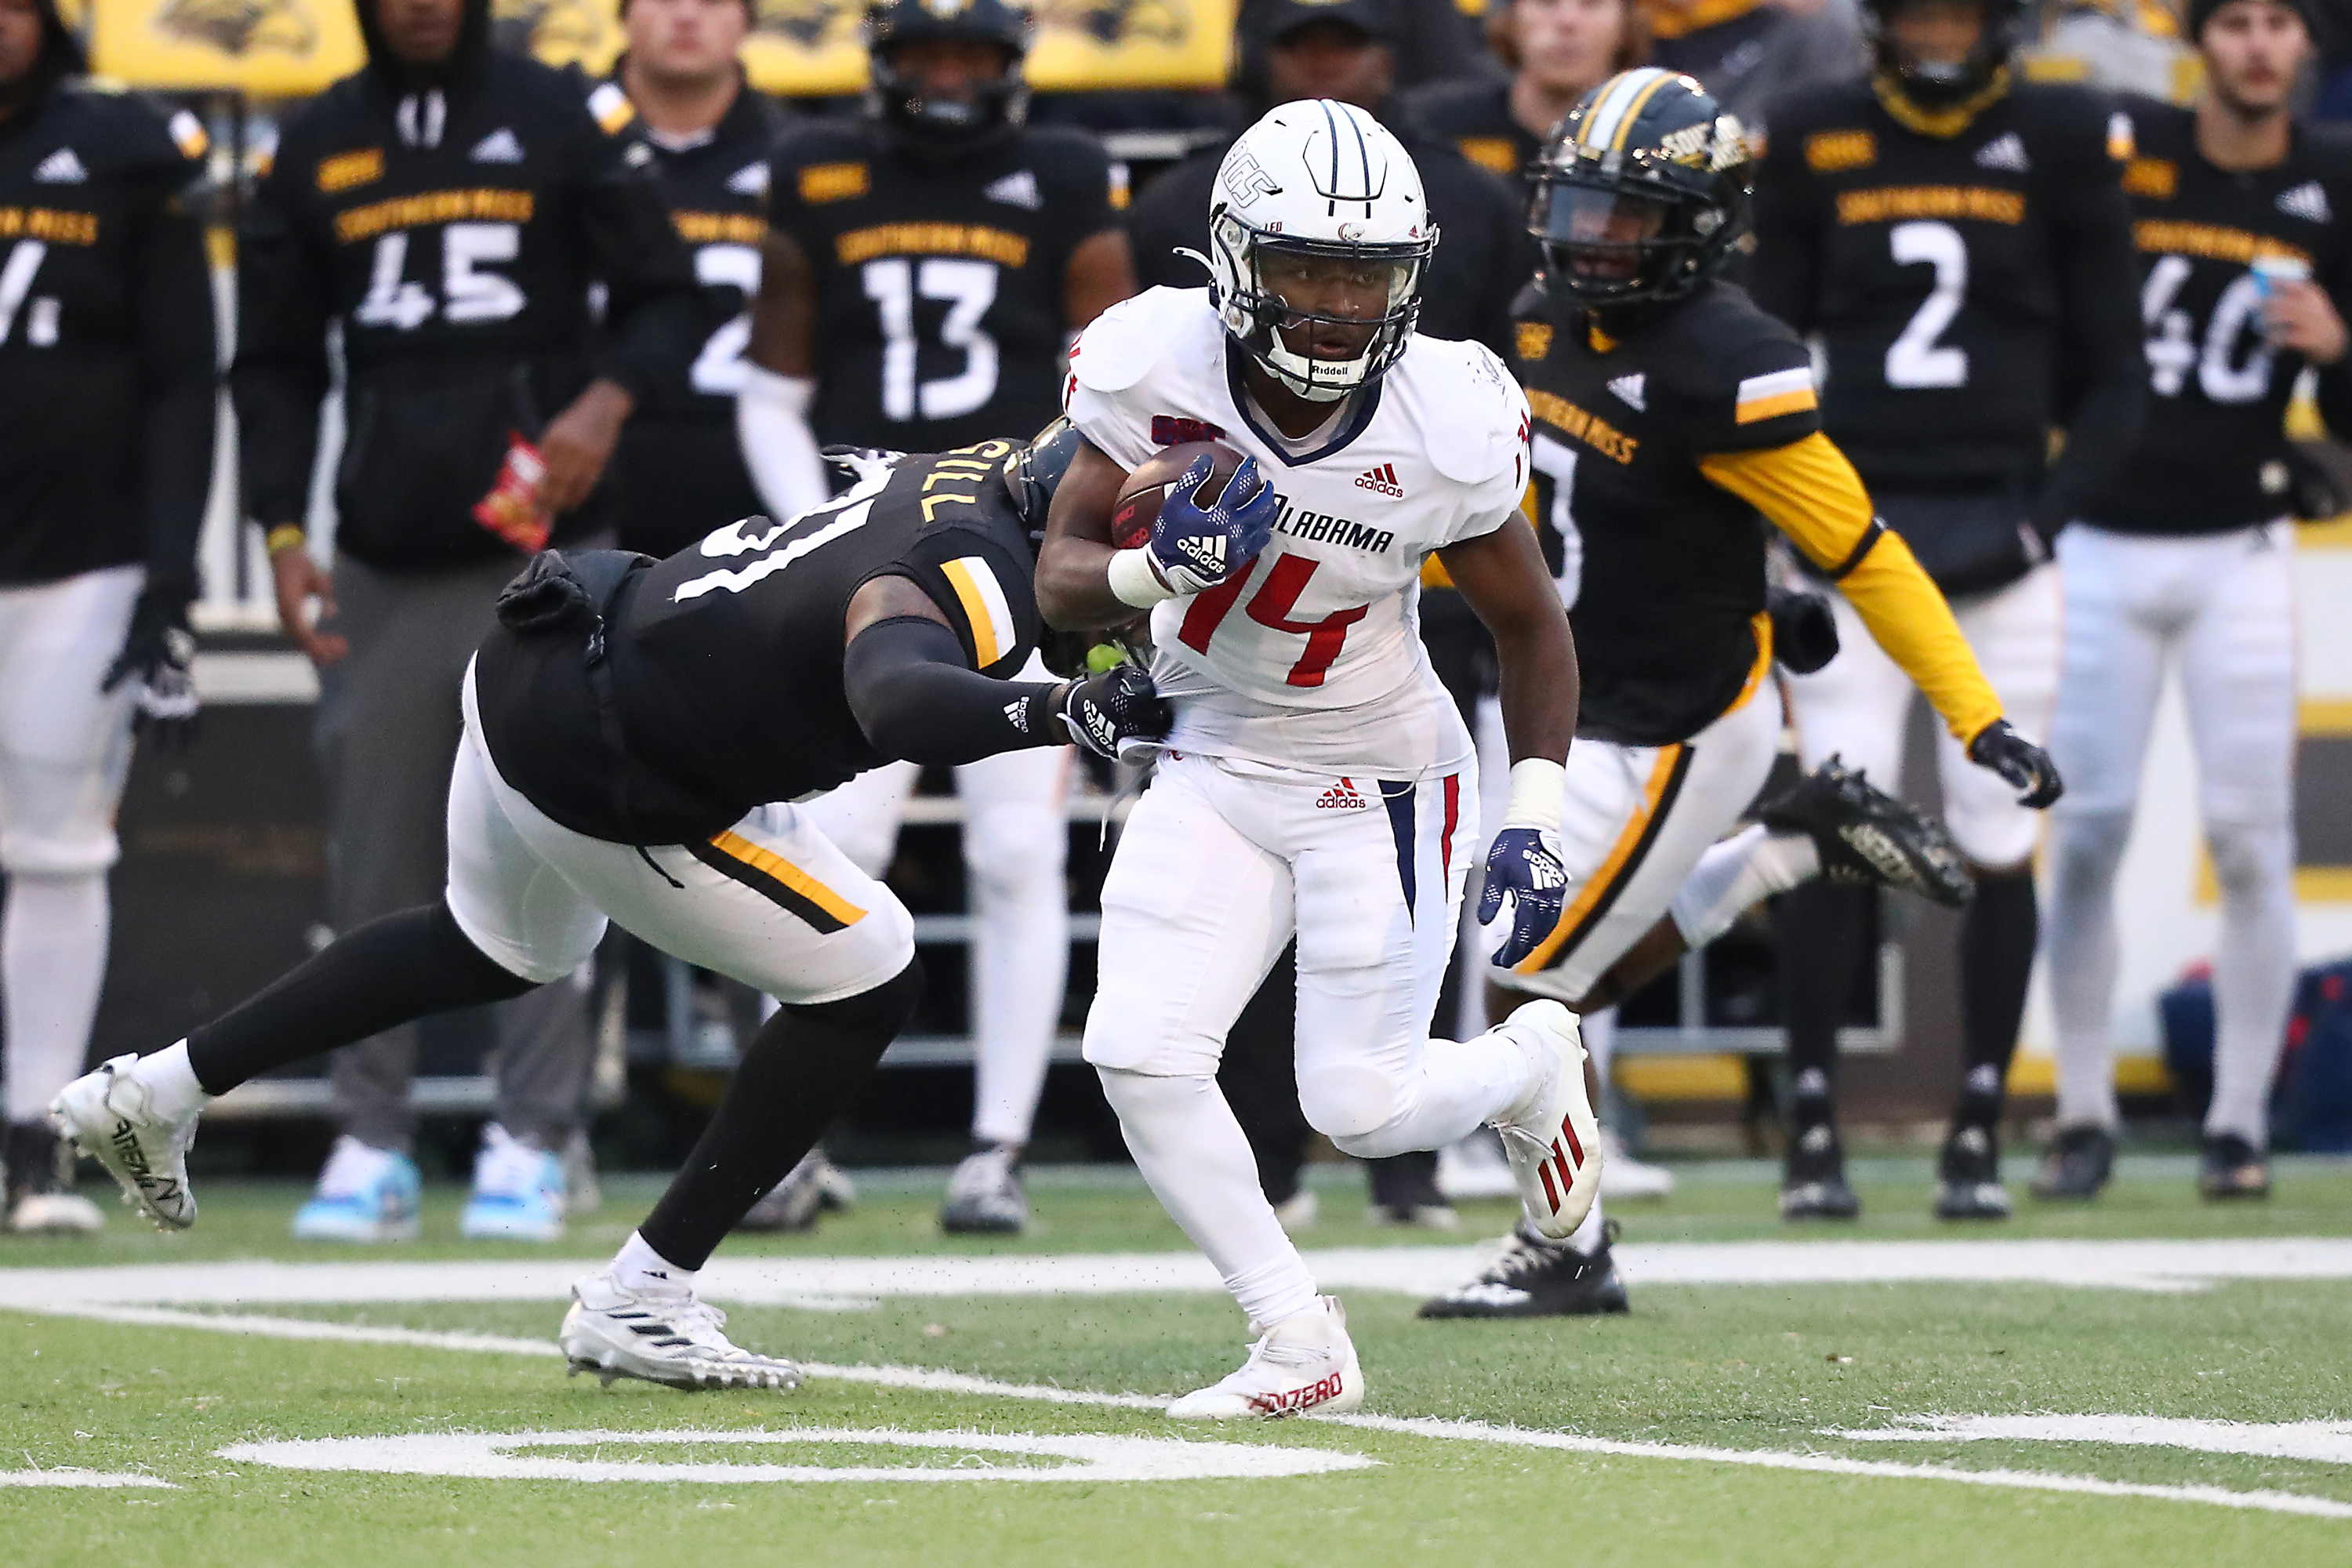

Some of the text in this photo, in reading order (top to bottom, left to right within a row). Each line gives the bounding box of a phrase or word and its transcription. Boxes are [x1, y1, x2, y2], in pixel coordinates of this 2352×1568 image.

[1221, 140, 1277, 209] AGS
[354, 222, 528, 330] 45
[1886, 220, 1968, 389] 2
[690, 245, 765, 394] 2
[862, 259, 1000, 421] 13
[2140, 253, 2273, 403] 40
[1312, 365, 1348, 375] Riddell
[1355, 477, 1403, 499] adidas
[1177, 538, 1226, 574] adidas
[1178, 552, 1370, 688] 14
[1083, 699, 1116, 752] adidas
[1316, 796, 1366, 808] adidas
[1522, 849, 1565, 884] adidas
